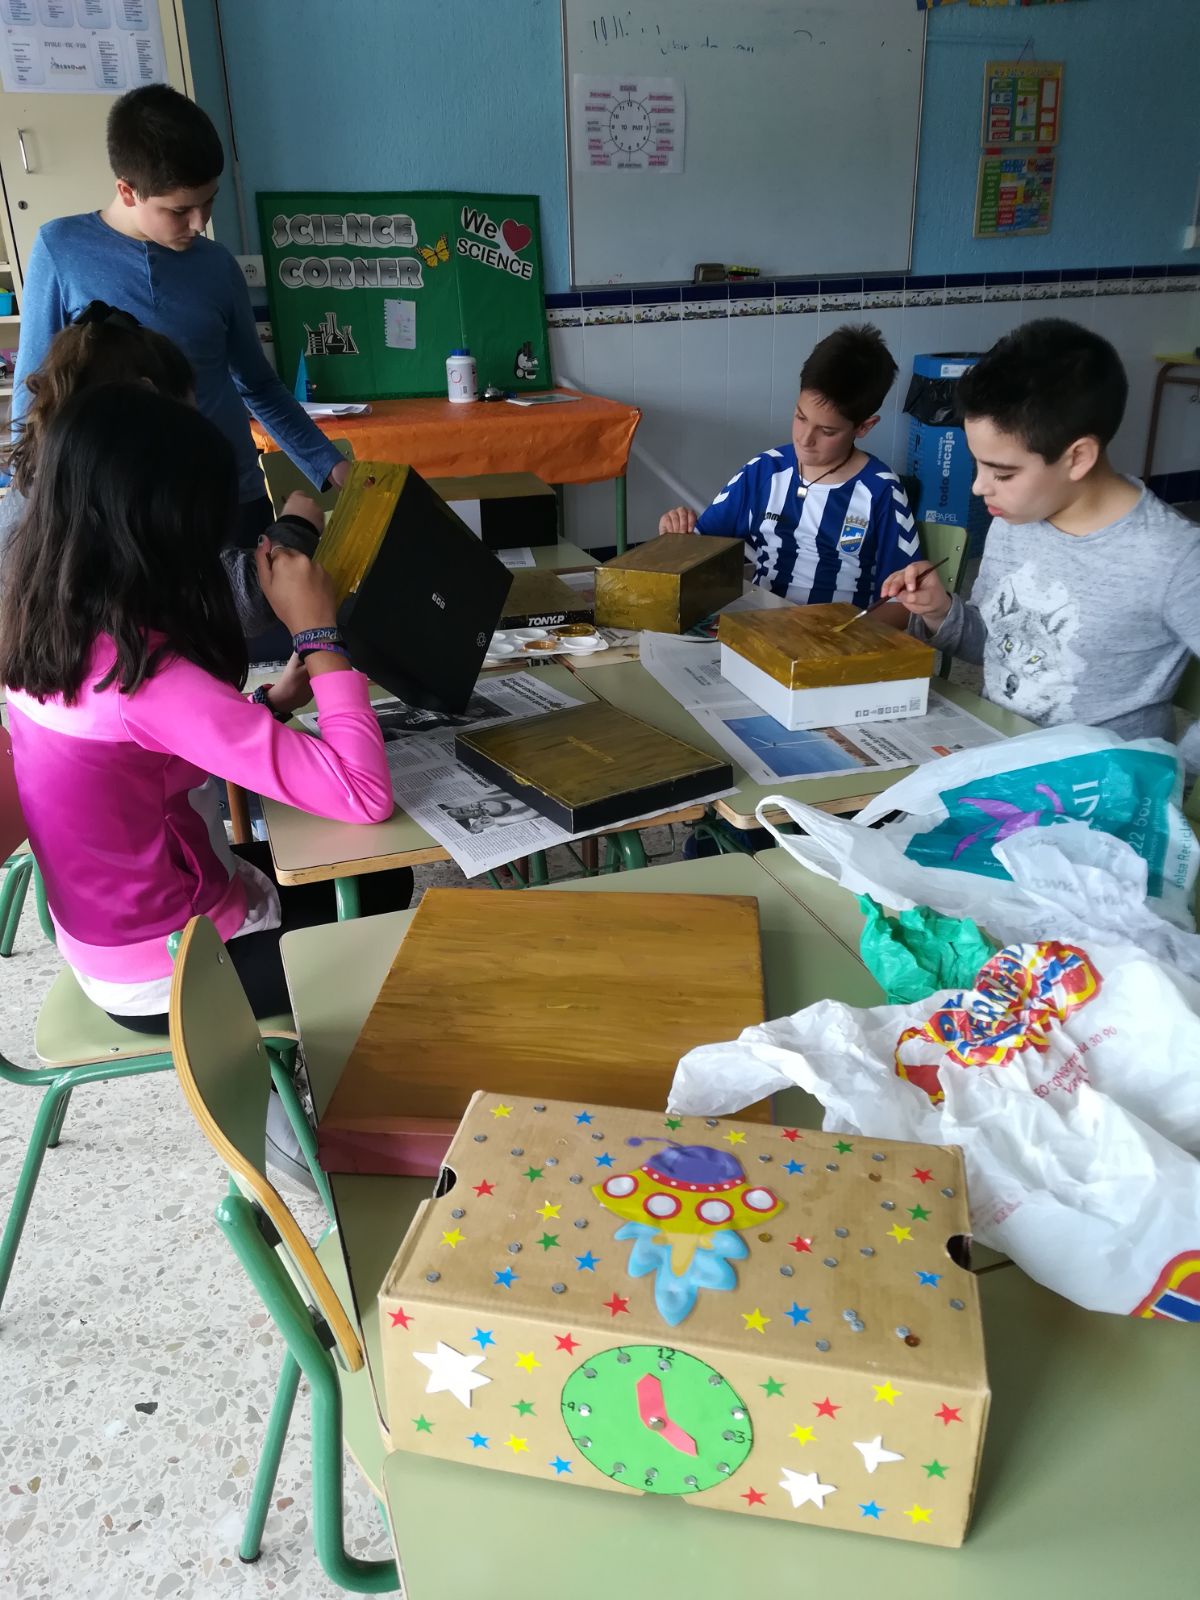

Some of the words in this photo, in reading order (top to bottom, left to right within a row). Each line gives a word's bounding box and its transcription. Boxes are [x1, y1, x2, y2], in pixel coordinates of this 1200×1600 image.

[273, 215, 414, 246] SCIENCE
[462, 206, 498, 239] We
[280, 258, 422, 287] CORNER
[457, 238, 533, 279] SCIENCE
[942, 431, 955, 477] encaja
[528, 615, 565, 626] TONY.P
[657, 1347, 676, 1360] 12
[566, 1401, 576, 1412] 9
[644, 1477, 654, 1487] 6
